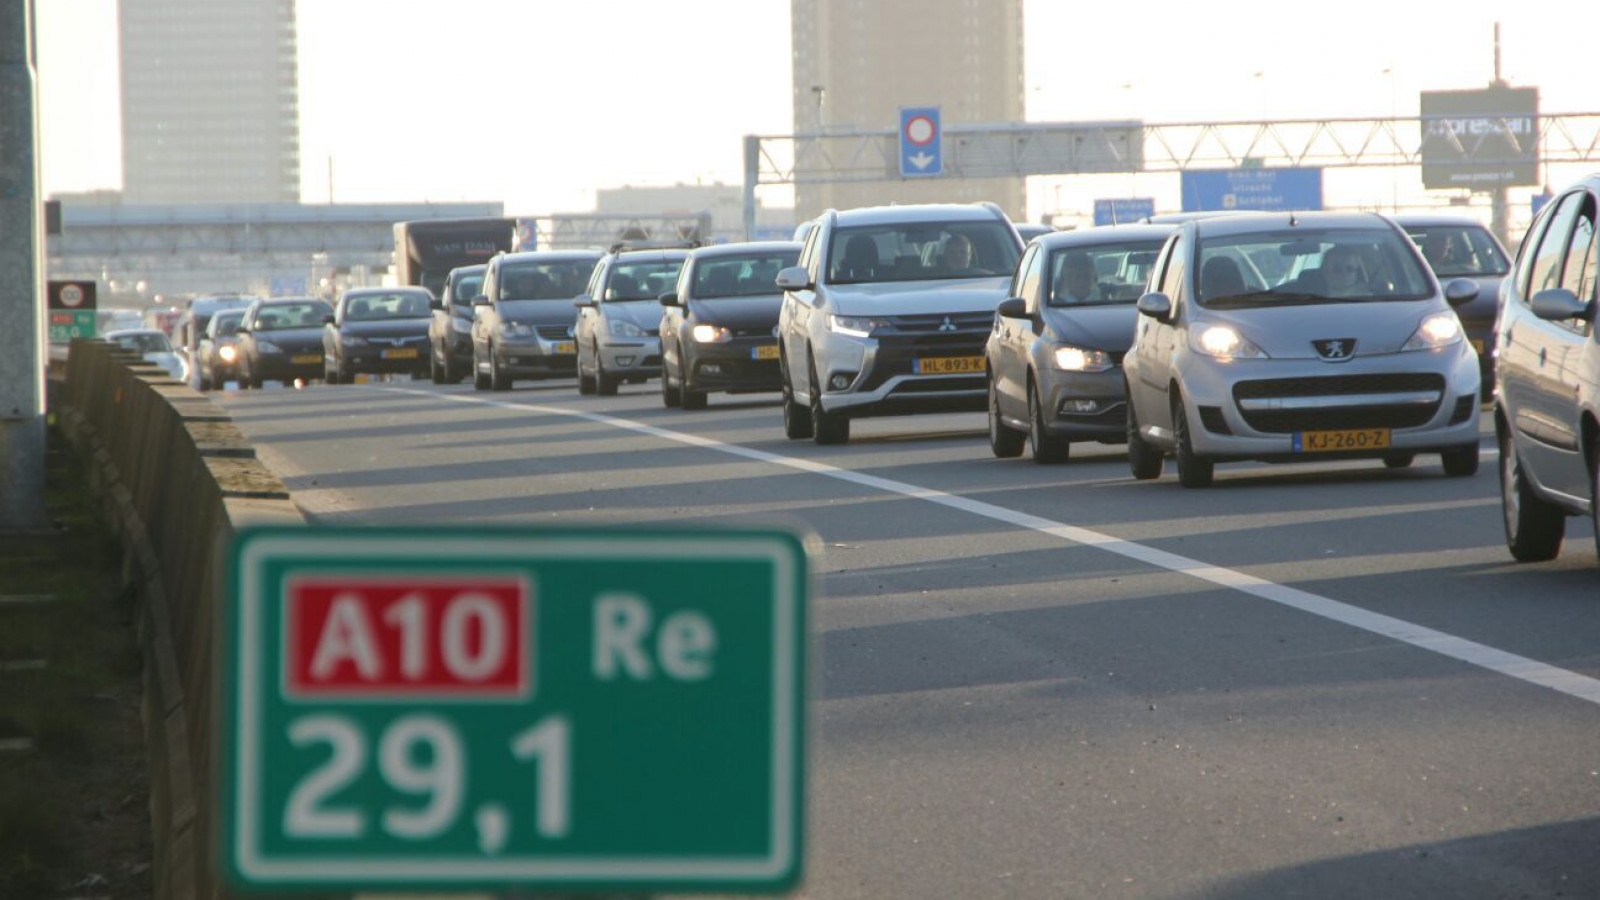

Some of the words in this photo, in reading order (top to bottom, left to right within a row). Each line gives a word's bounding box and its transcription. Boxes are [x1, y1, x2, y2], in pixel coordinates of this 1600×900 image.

[923, 357, 981, 372] HL-893-K
[1309, 430, 1384, 449] KJ-260-Z
[309, 593, 508, 680] A10
[592, 593, 715, 680] Re
[284, 714, 571, 852] 29,1
